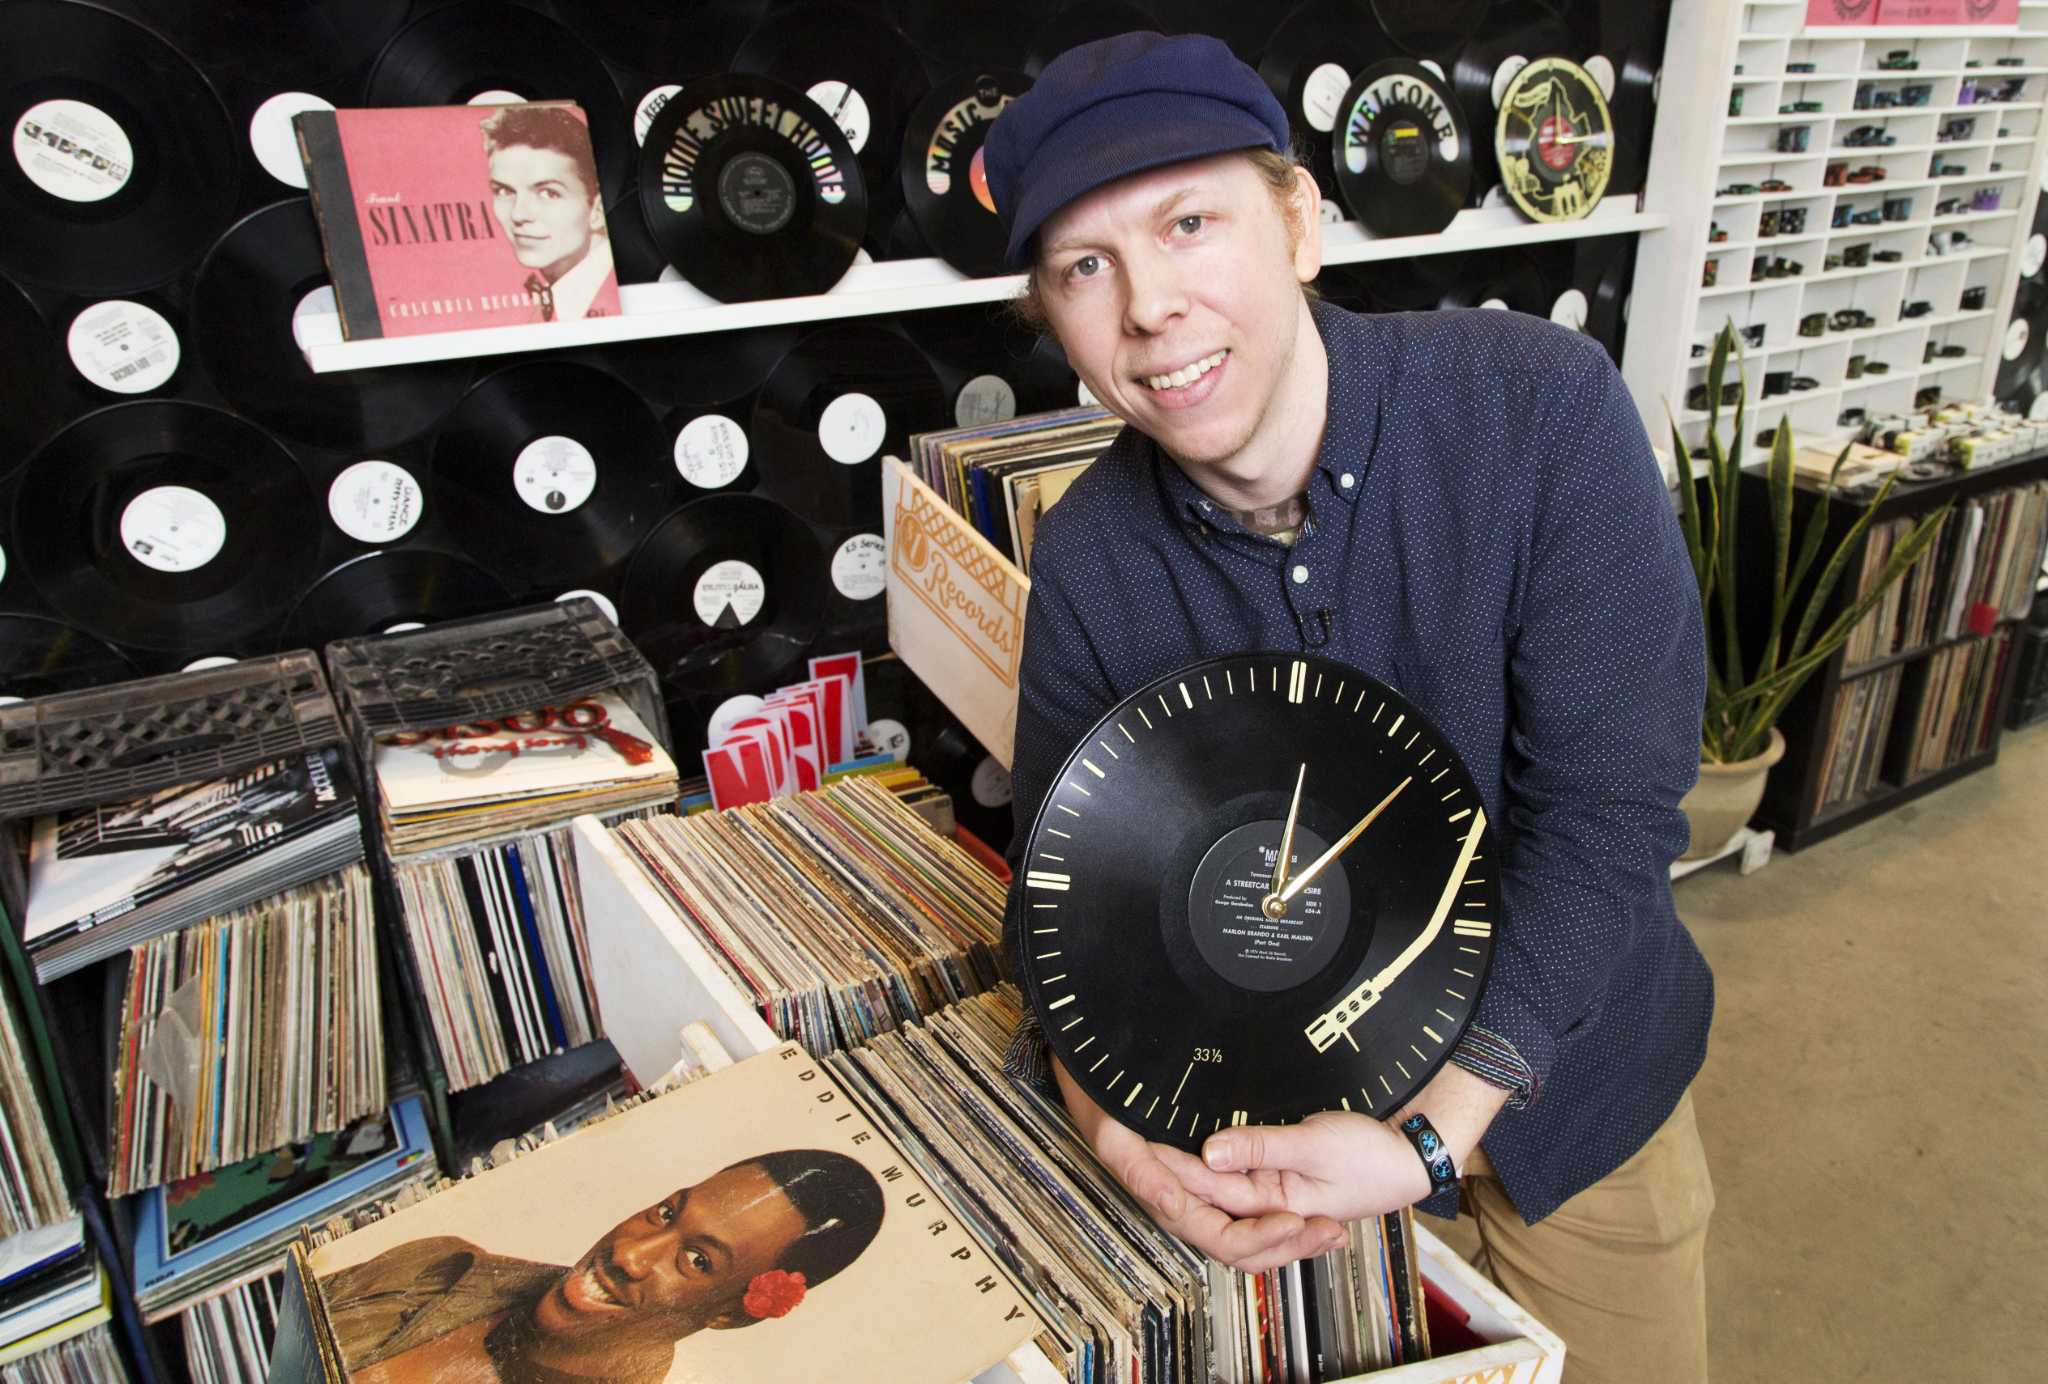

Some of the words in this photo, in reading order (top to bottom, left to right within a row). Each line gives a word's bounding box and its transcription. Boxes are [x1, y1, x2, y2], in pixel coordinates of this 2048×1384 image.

[929, 103, 977, 174] MUSIC
[1347, 80, 1453, 149] WELCOME
[367, 201, 496, 247] SINATRA
[388, 298, 474, 319] COLUMBIA
[480, 291, 552, 312] RECORDS
[924, 551, 1013, 654] Records
[1233, 879, 1269, 890] STREETCAR
[1222, 928, 1246, 936] MARLON
[1247, 930, 1270, 938] BRANDO
[779, 1047, 871, 1146] EDDIE
[880, 1165, 1025, 1323] MURPHY
